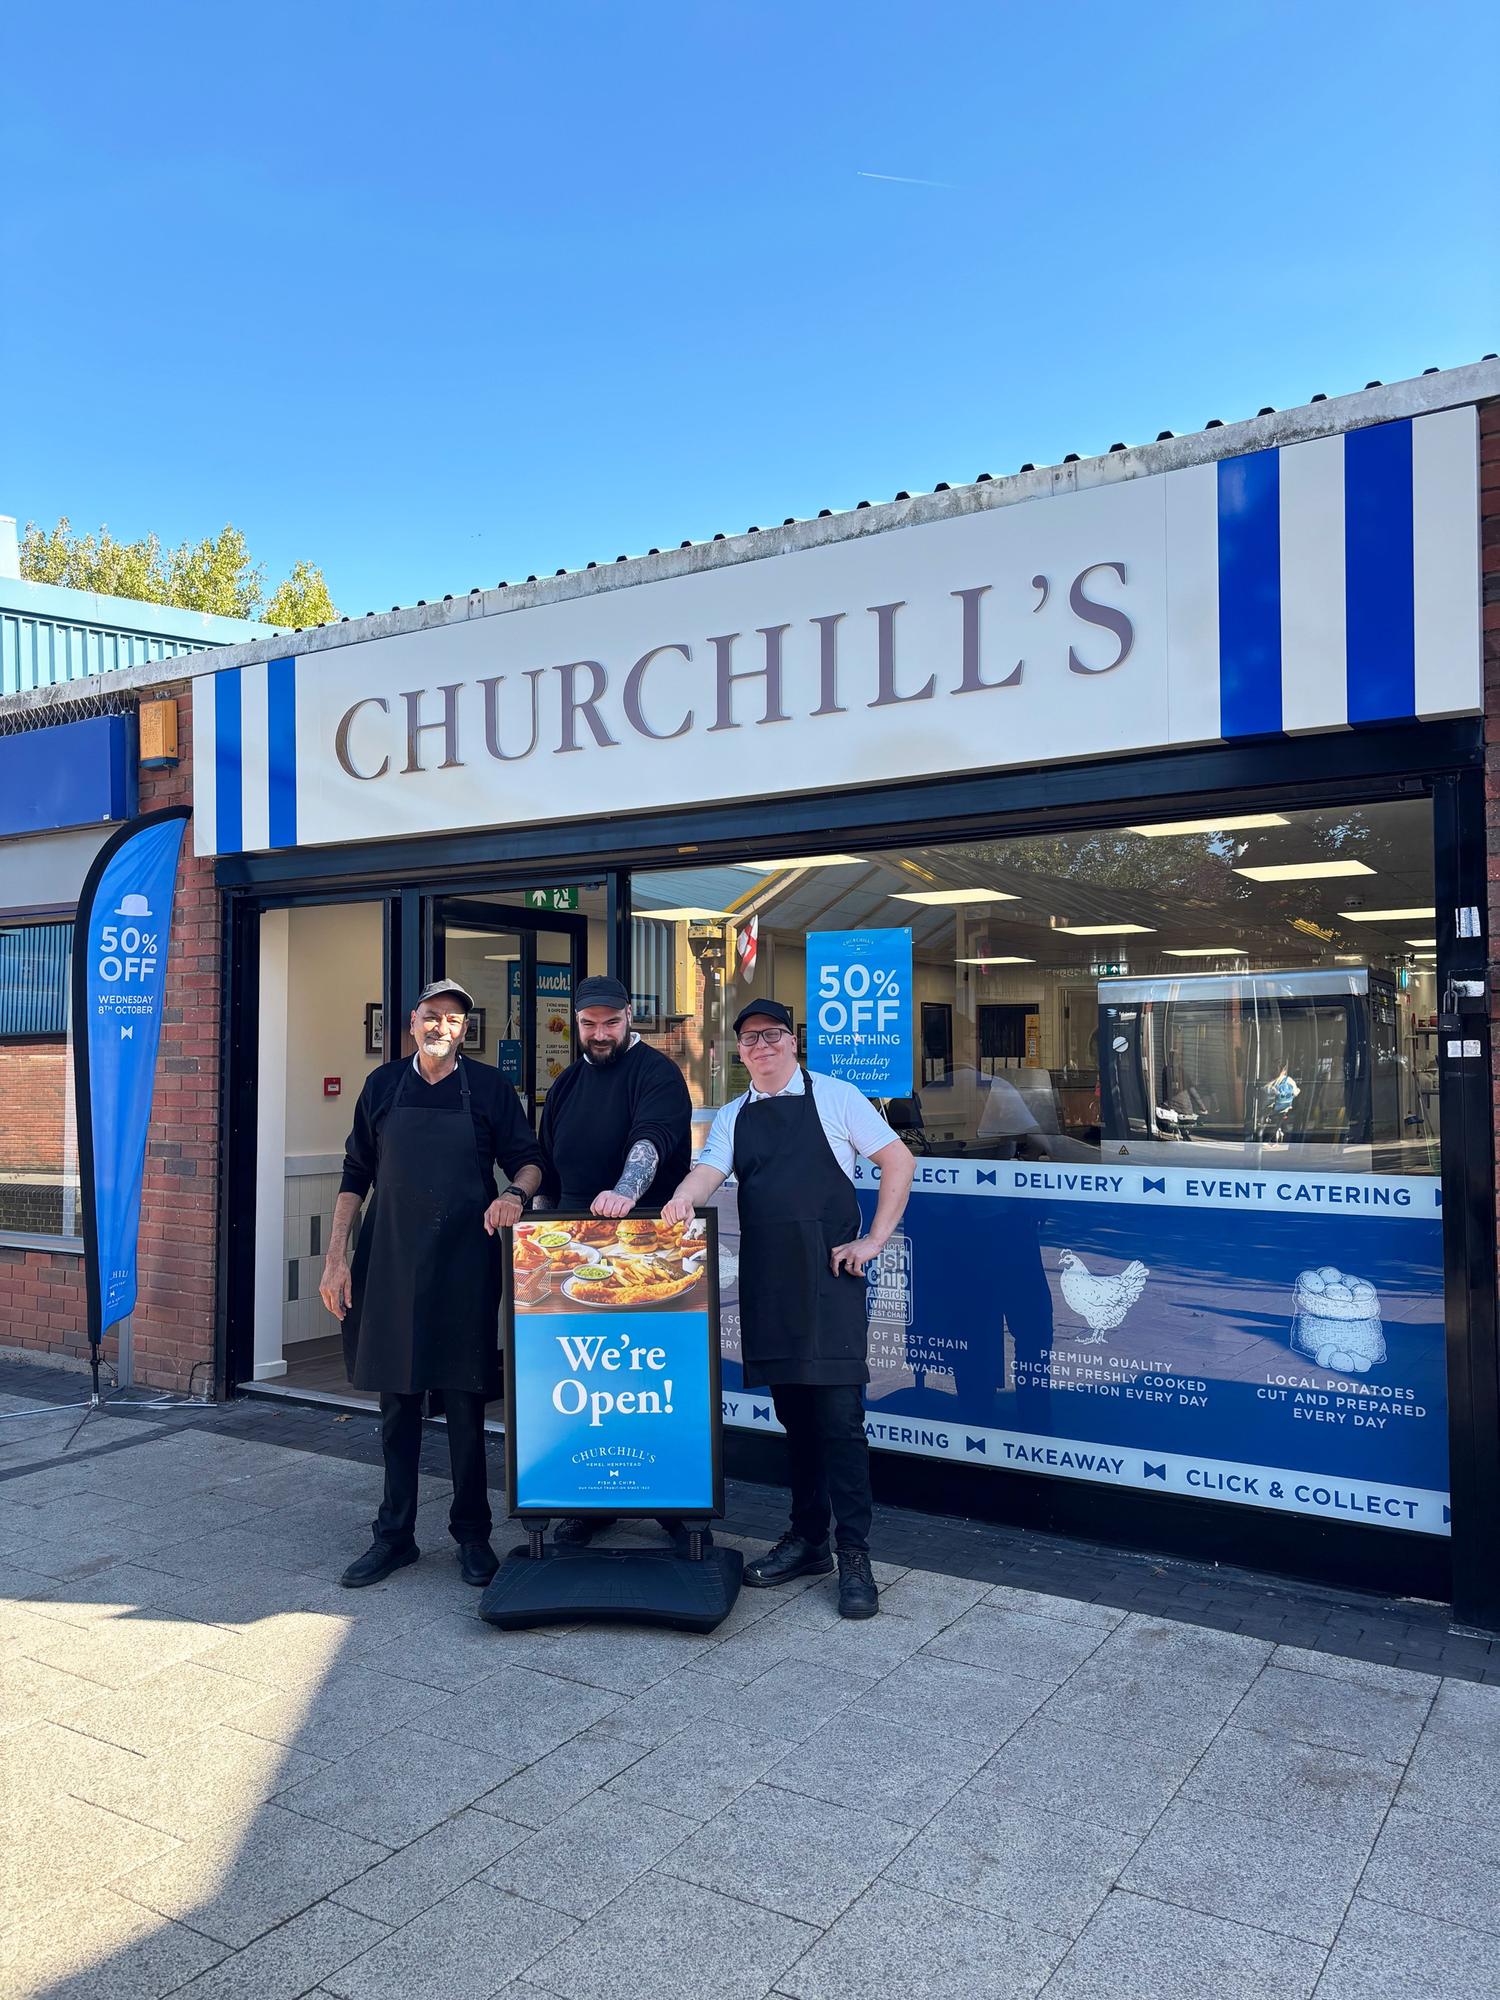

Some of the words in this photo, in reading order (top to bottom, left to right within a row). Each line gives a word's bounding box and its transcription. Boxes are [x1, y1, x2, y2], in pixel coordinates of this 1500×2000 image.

[334, 561, 1135, 781] CHURCHILL'S
[99, 926, 158, 955] 50%
[98, 955, 157, 982] OFF
[818, 964, 900, 999] 50%
[98, 994, 154, 1004] WEDNESDAY
[98, 1005, 113, 1015] 8TH
[115, 1005, 153, 1015] OCTOBER
[818, 1000, 900, 1033] OFF
[818, 1034, 901, 1045] EVERYTHING
[830, 1053, 891, 1069] Wednesday
[846, 1068, 891, 1081] October
[854, 1165, 864, 1180] &
[1014, 1172, 1124, 1193] DELIVERY
[1186, 1180, 1267, 1200] EVENT
[1276, 1183, 1411, 1207] CATERING
[867, 1268, 908, 1289] Chip
[869, 1287, 907, 1300] Awards
[869, 1299, 908, 1312] WINNER
[887, 1311, 908, 1319] CHAIN
[720, 1340, 739, 1350] ERY
[872, 1330, 889, 1341] OF
[893, 1332, 924, 1345] BEST
[928, 1337, 968, 1350] CHAIN
[555, 1333, 667, 1372] We're
[881, 1345, 945, 1361] NATIONAL
[1040, 1350, 1103, 1366] PREMIUM
[1109, 1357, 1173, 1374] QUALITY
[869, 1357, 897, 1369] CHIP
[901, 1361, 955, 1376] AWARDS
[1010, 1360, 1070, 1377] CHICKEN
[1076, 1368, 1138, 1384] FRESHLY
[1143, 1375, 1207, 1392] COOKED
[1009, 1374, 1027, 1385] TO
[1032, 1377, 1120, 1397] PERFECTION
[1126, 1388, 1173, 1403] EVERY
[1179, 1394, 1209, 1408] DAY
[1266, 1373, 1320, 1390] LOCAL
[1326, 1380, 1415, 1400] POTATOES
[552, 1379, 674, 1427] Open!
[1256, 1388, 1288, 1401] CUT
[1294, 1392, 1329, 1406] AND
[1336, 1397, 1427, 1418] PREPARED
[1293, 1407, 1347, 1424] EVERY
[1353, 1415, 1387, 1429] DAY
[864, 1422, 950, 1449] ATERING
[1003, 1442, 1125, 1476] TAKEAWAY
[1186, 1469, 1260, 1496] CLICK
[1268, 1480, 1284, 1499] &
[1294, 1485, 1420, 1520] COLLECT
